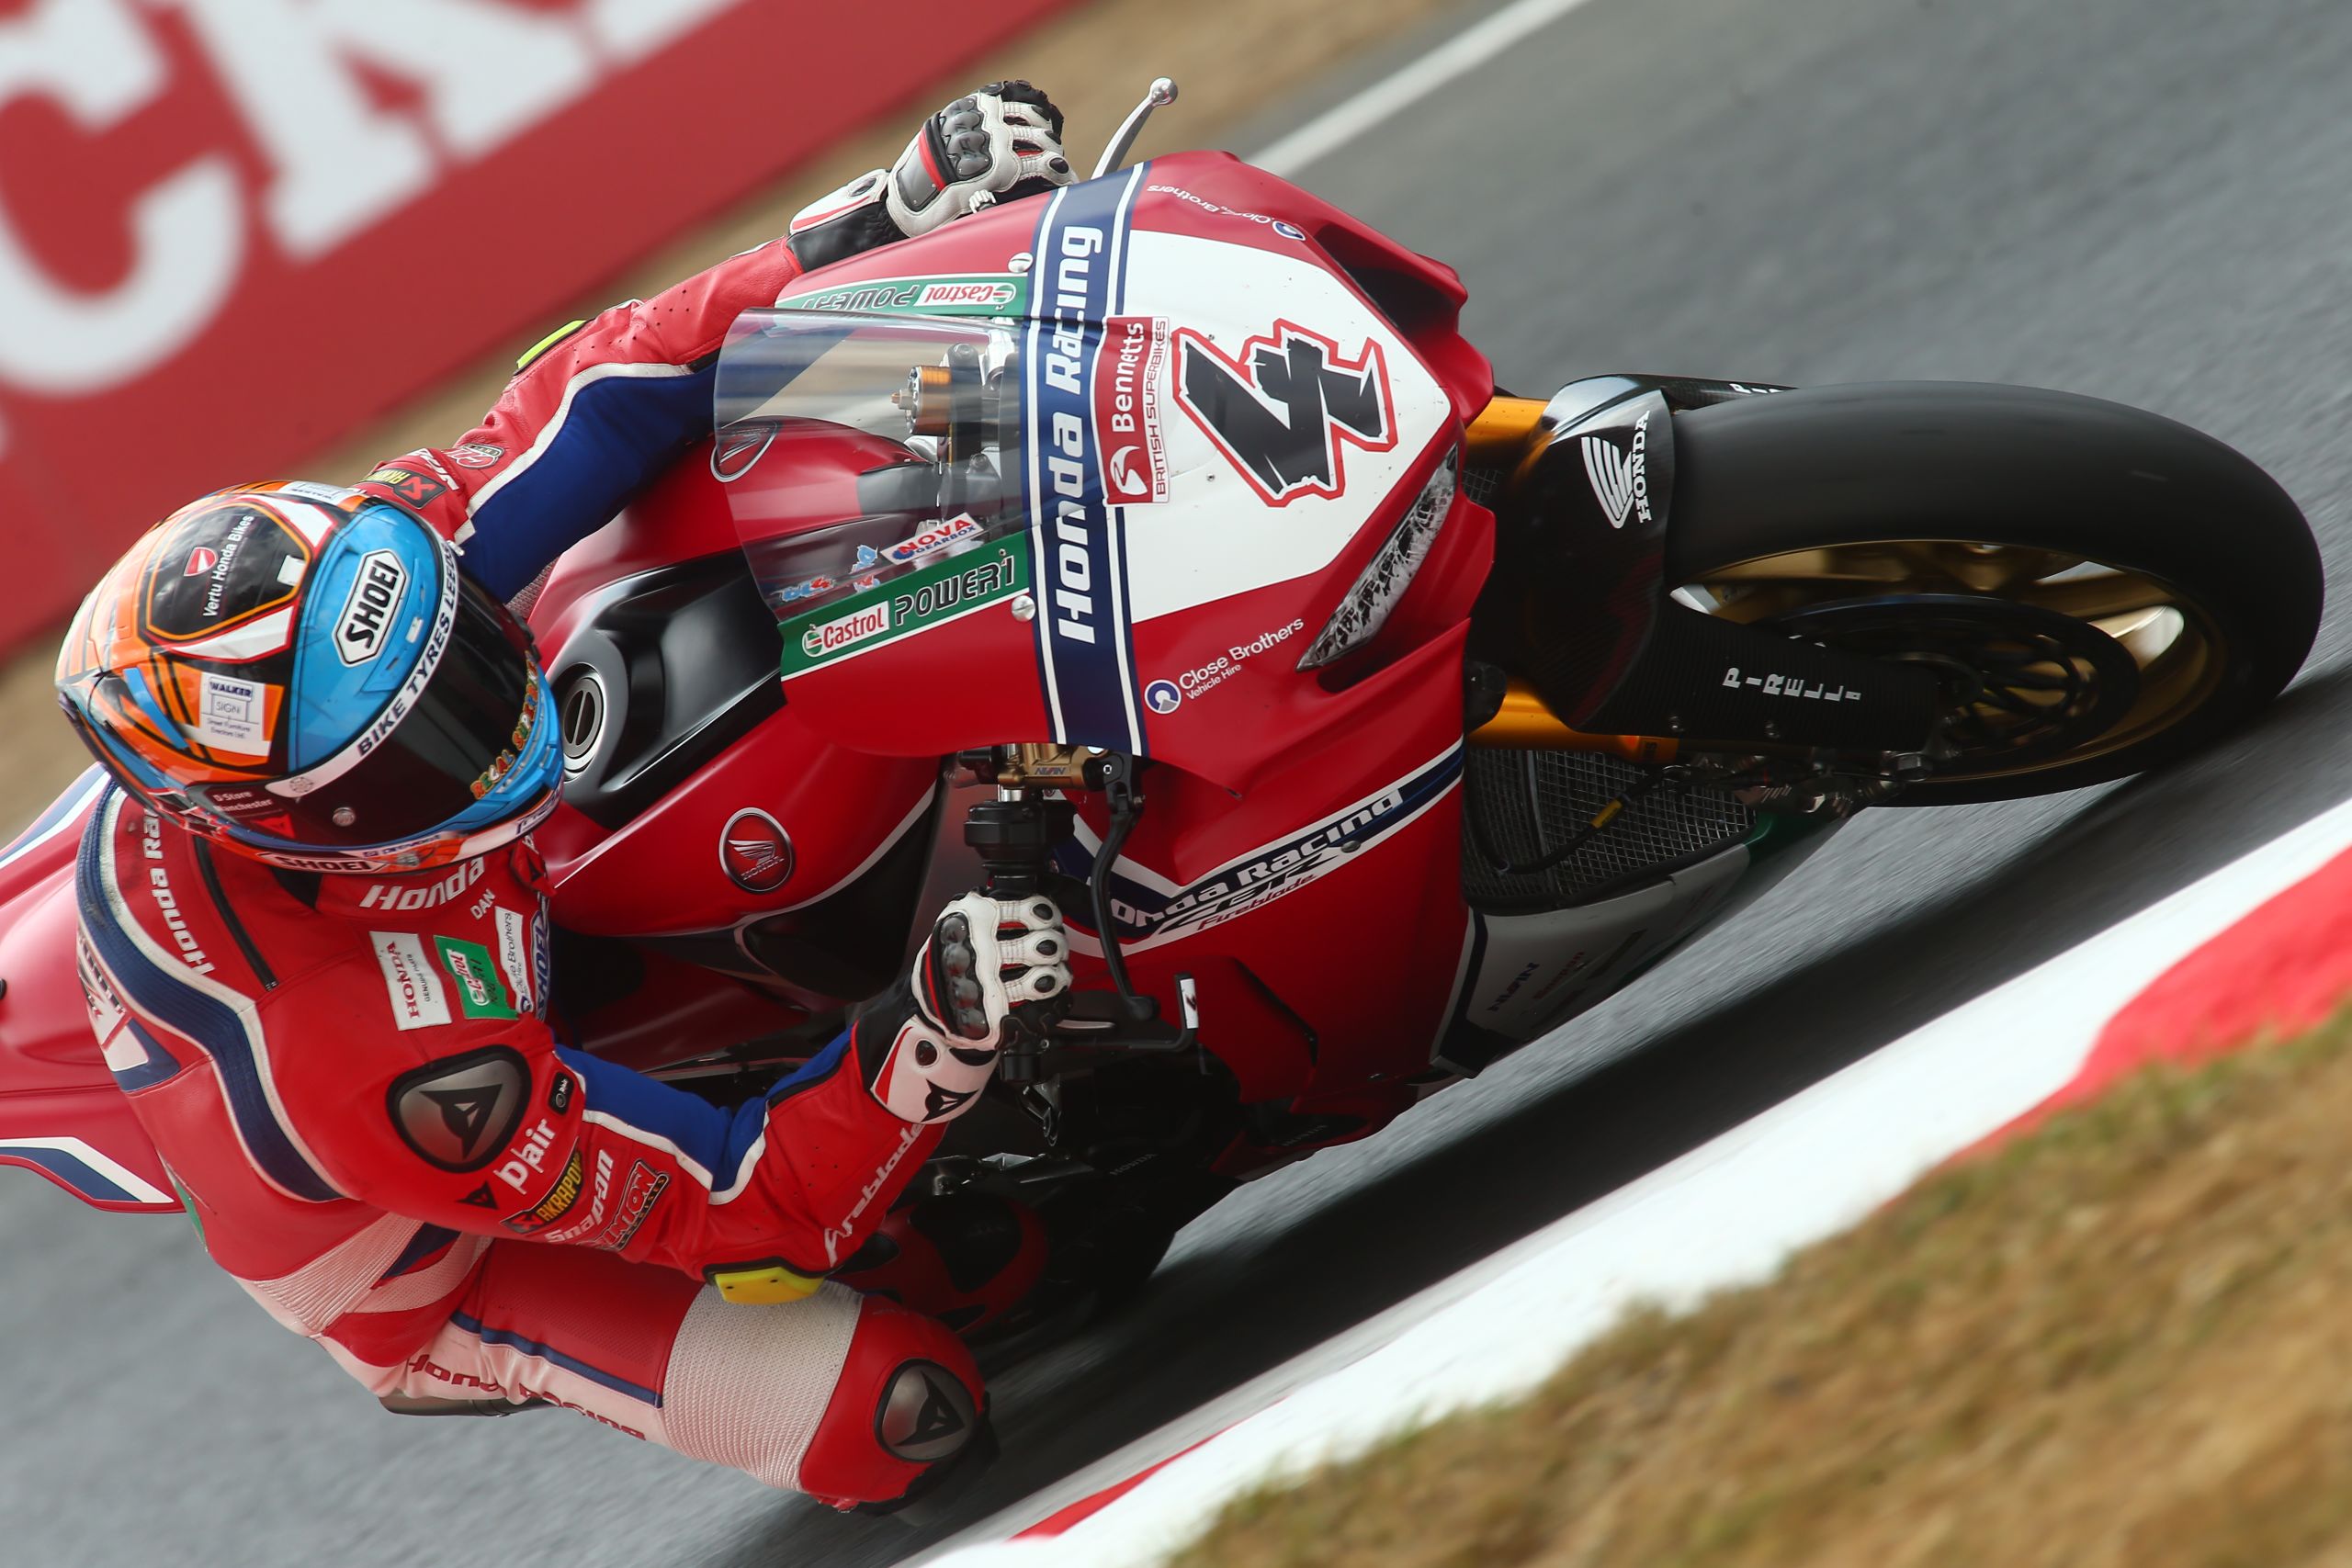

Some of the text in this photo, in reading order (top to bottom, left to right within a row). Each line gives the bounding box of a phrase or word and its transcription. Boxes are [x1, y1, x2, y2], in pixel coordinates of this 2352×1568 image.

[1147, 184, 1220, 213] Brothers
[925, 282, 995, 303] Castrol
[1111, 321, 1145, 434] Bennetts
[1144, 320, 1167, 497] BRITISH SUPERBIKES
[1178, 325, 1390, 502] 4
[1045, 225, 1104, 645] Honda Racing
[1632, 410, 1653, 525] HONDA
[202, 514, 255, 617] Vertu Honda Bikes
[898, 518, 972, 554] NOVA
[915, 525, 977, 554] GEARBOX
[345, 558, 402, 650] SHOEI
[823, 606, 885, 649] Castrol
[894, 552, 1016, 626] POWER1
[355, 540, 460, 758] BIKE TYRES LEEDS
[1178, 617, 1305, 690] Close Brothers
[1186, 664, 1242, 700] Vehicle Hire
[1723, 667, 1862, 704] PIRELLI
[209, 682, 253, 697] WALKER
[469, 748, 516, 800] REGAL
[274, 856, 372, 872] SHOEI
[358, 855, 487, 911] Honda
[740, 855, 786, 882] HONDA
[1110, 786, 1408, 928] onda Racing
[150, 871, 216, 976] Honda
[469, 887, 497, 921] DAN
[1196, 874, 1319, 932] Fireblade
[385, 941, 421, 1020] HONDA
[537, 1150, 582, 1223] AKRAPOV
